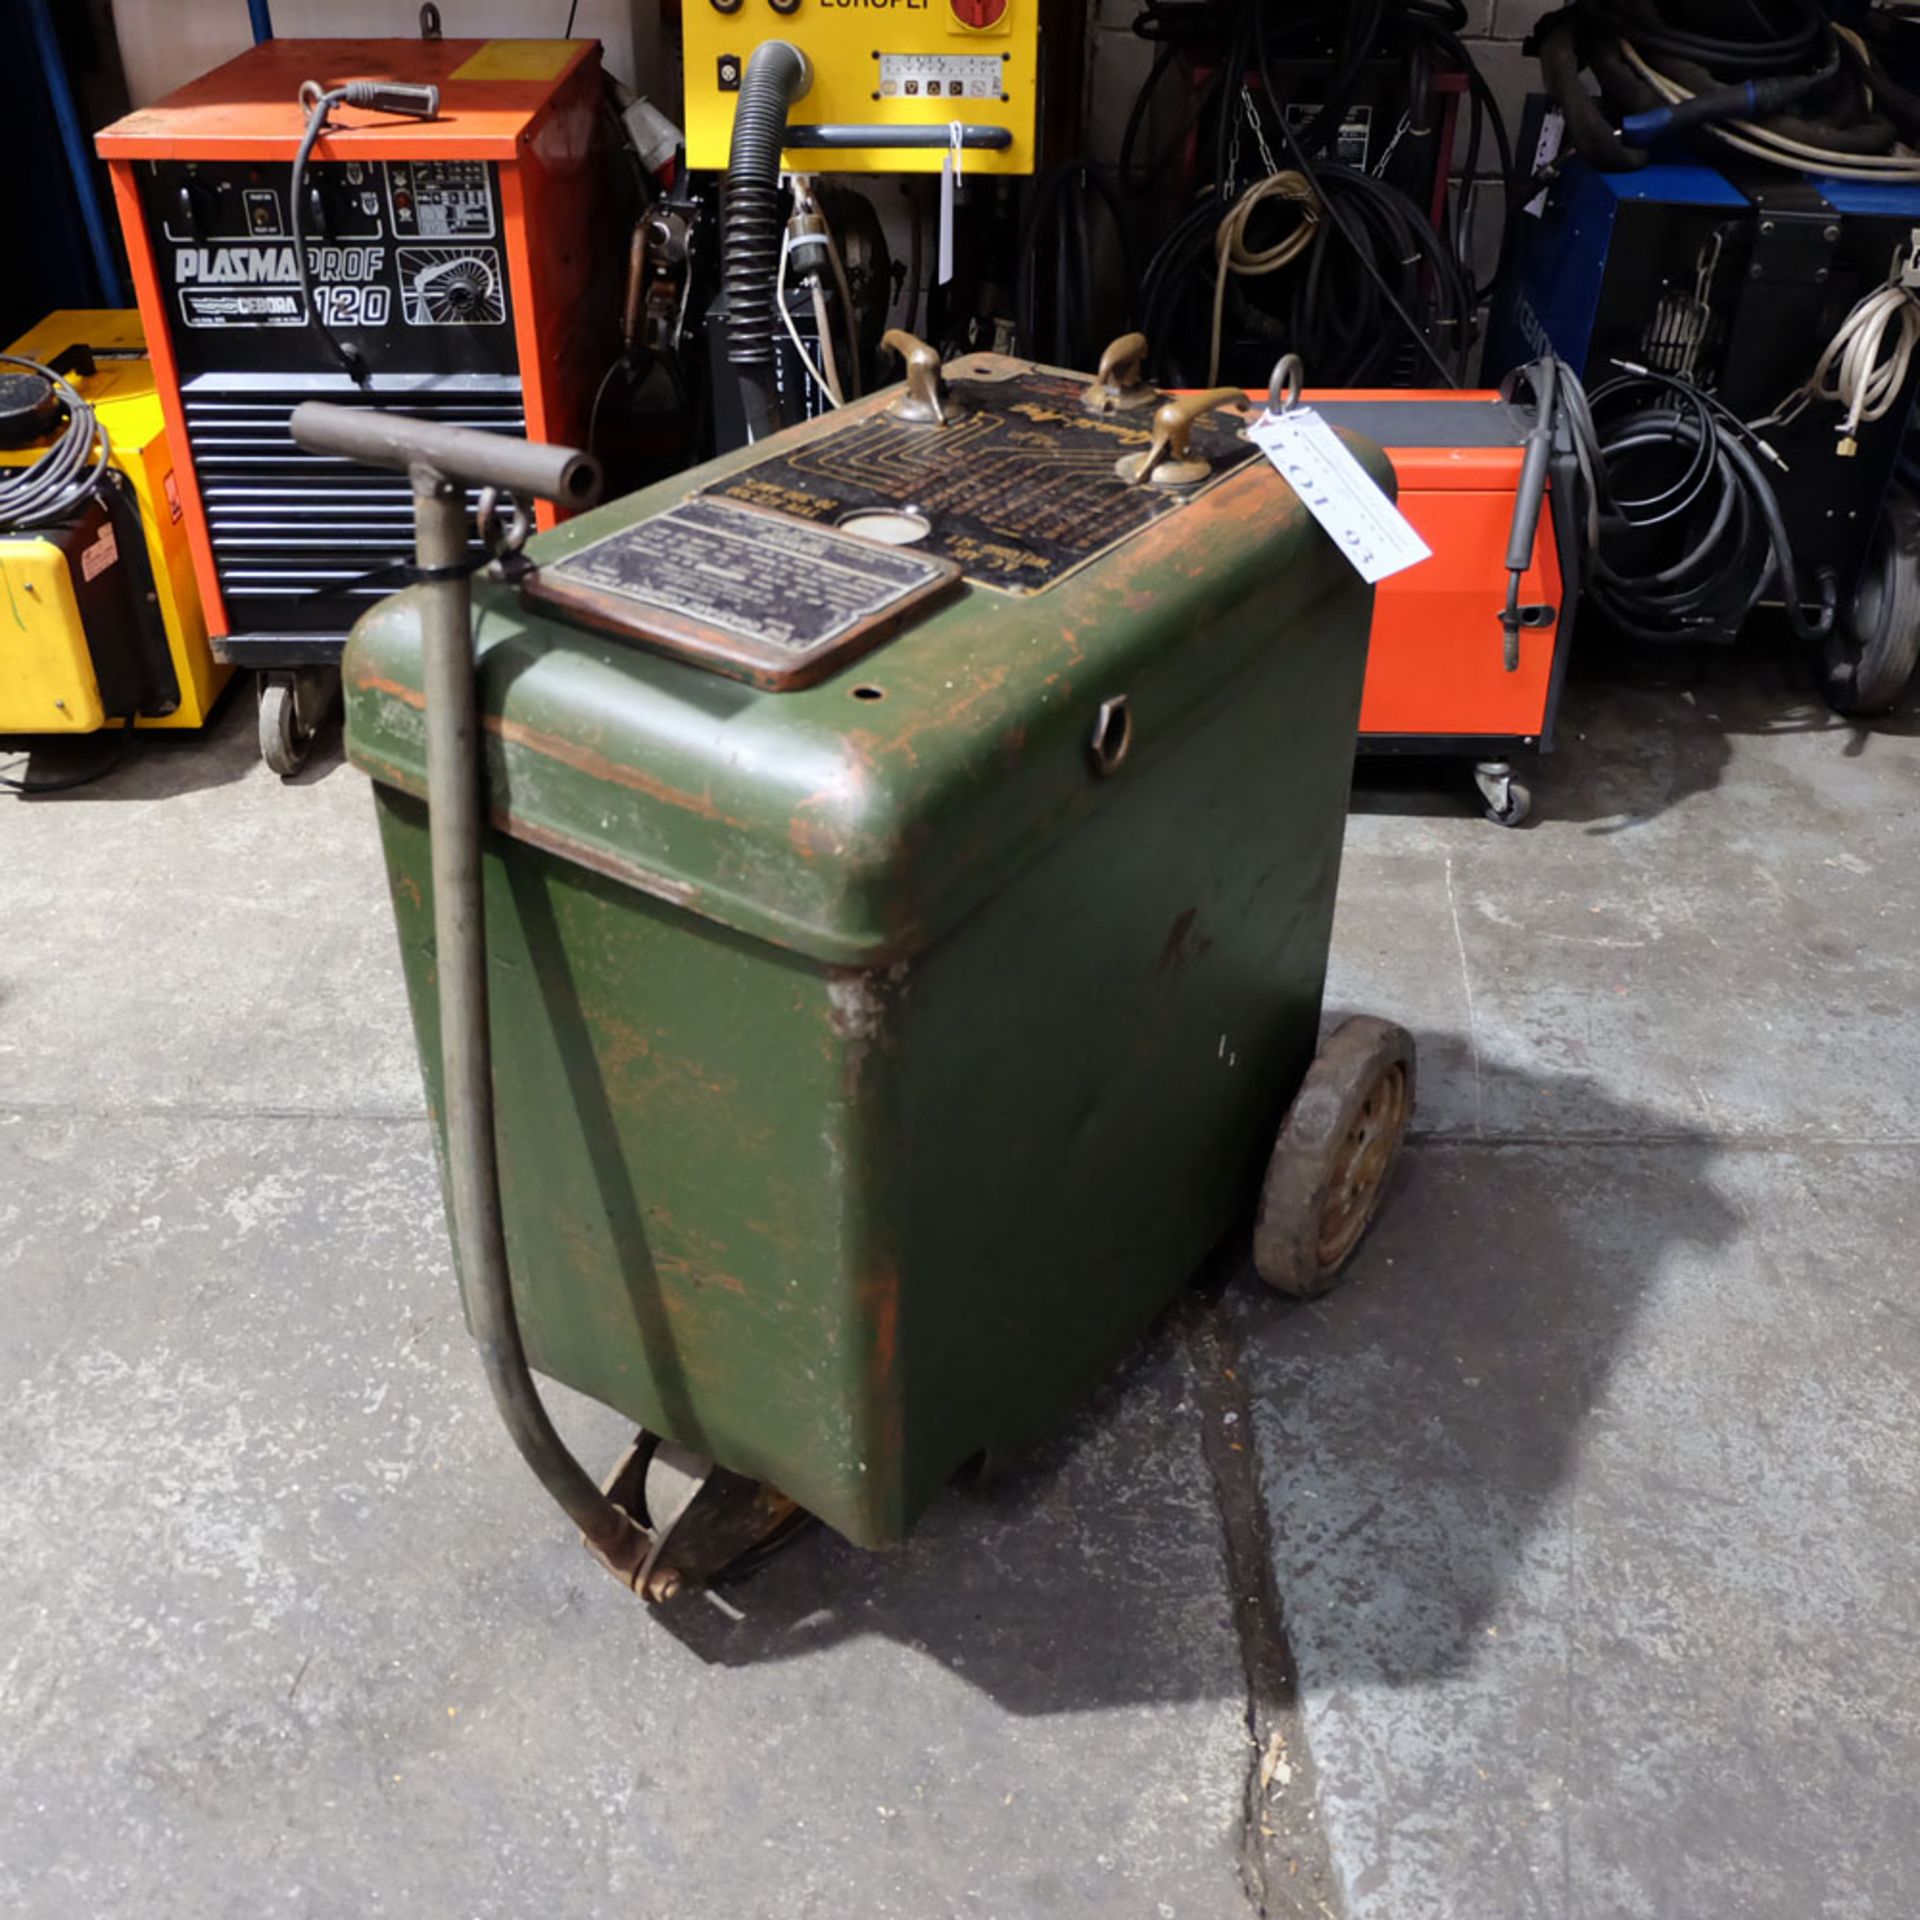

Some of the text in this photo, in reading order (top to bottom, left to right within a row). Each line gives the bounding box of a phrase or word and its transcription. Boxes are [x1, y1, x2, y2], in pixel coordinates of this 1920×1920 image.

[175, 248, 301, 283] PLASMA
[237, 297, 298, 314] CEBORA
[314, 285, 391, 326] 120
